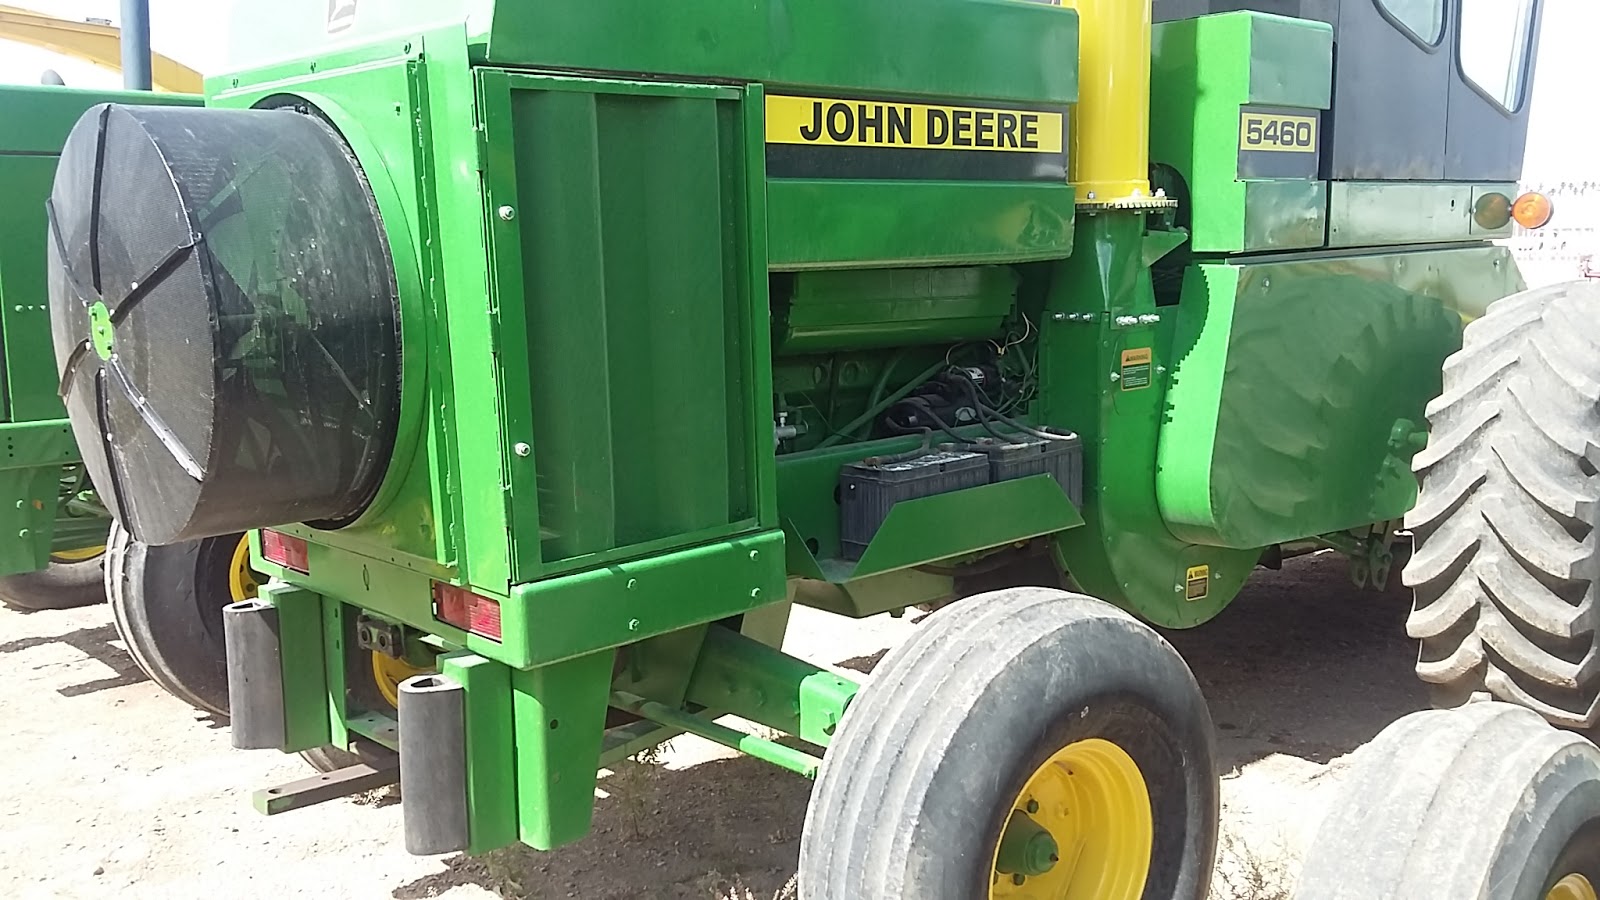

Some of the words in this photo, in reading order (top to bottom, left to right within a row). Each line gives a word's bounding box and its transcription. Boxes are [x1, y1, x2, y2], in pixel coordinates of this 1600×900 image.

[800, 102, 912, 145] JOHN
[926, 108, 1039, 149] DEERE
[1246, 119, 1312, 147] 5460
